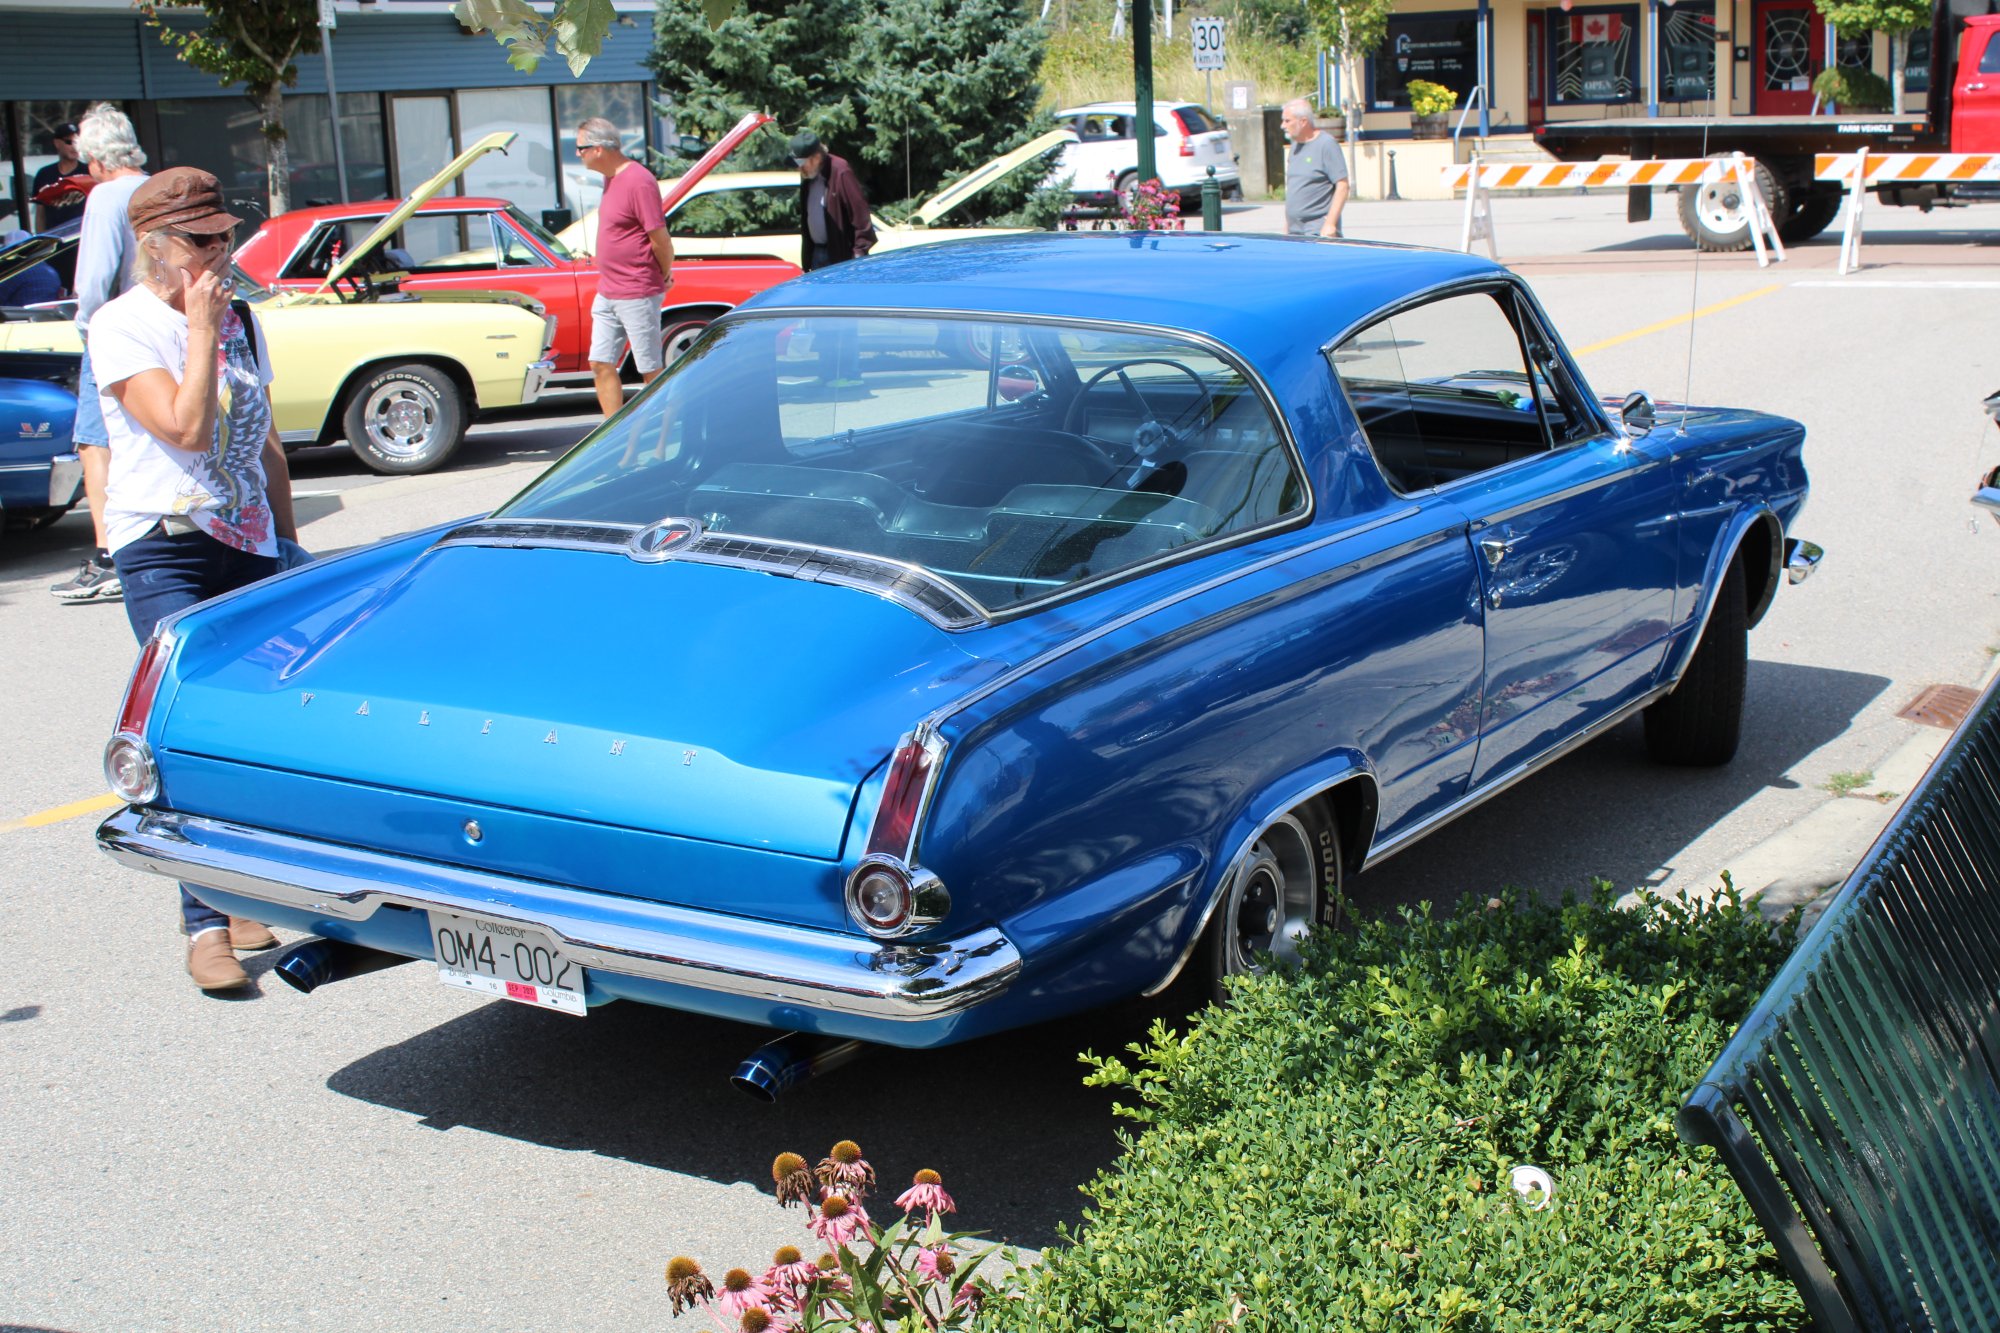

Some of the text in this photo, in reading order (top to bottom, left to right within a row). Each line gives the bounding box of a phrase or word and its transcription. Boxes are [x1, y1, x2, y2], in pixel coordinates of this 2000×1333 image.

[1198, 25, 1220, 51] 30
[1905, 66, 1929, 77] OPE
[1584, 79, 1612, 91] OPEN
[1677, 76, 1706, 86] OPEN
[1838, 124, 1894, 133] FARM VEHICLE
[371, 373, 441, 399] BFGoodrich
[386, 452, 427, 464] Radial
[301, 691, 698, 766] VALIANT
[1318, 830, 1335, 924] COOPE
[475, 920, 526, 939] Collector
[542, 985, 578, 1002] Columbia
